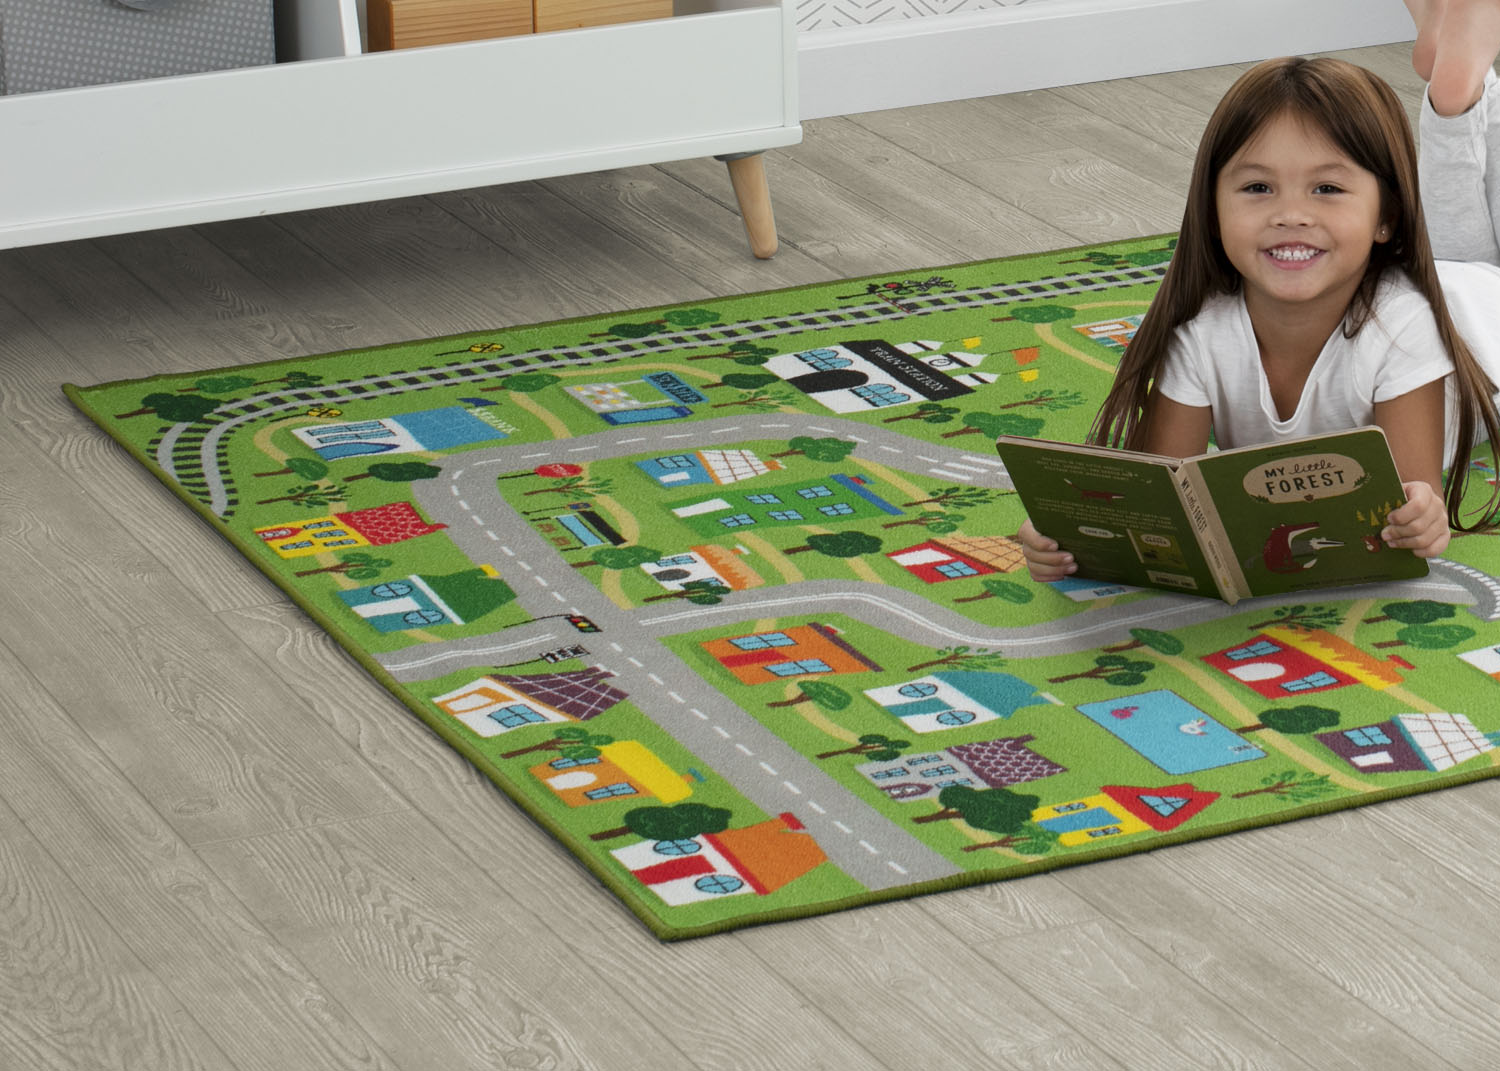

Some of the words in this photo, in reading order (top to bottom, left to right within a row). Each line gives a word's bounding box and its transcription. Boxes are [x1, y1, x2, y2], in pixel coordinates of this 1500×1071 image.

[1263, 466, 1285, 479] MY
[1288, 459, 1337, 475] little
[1264, 469, 1345, 496] FOREST
